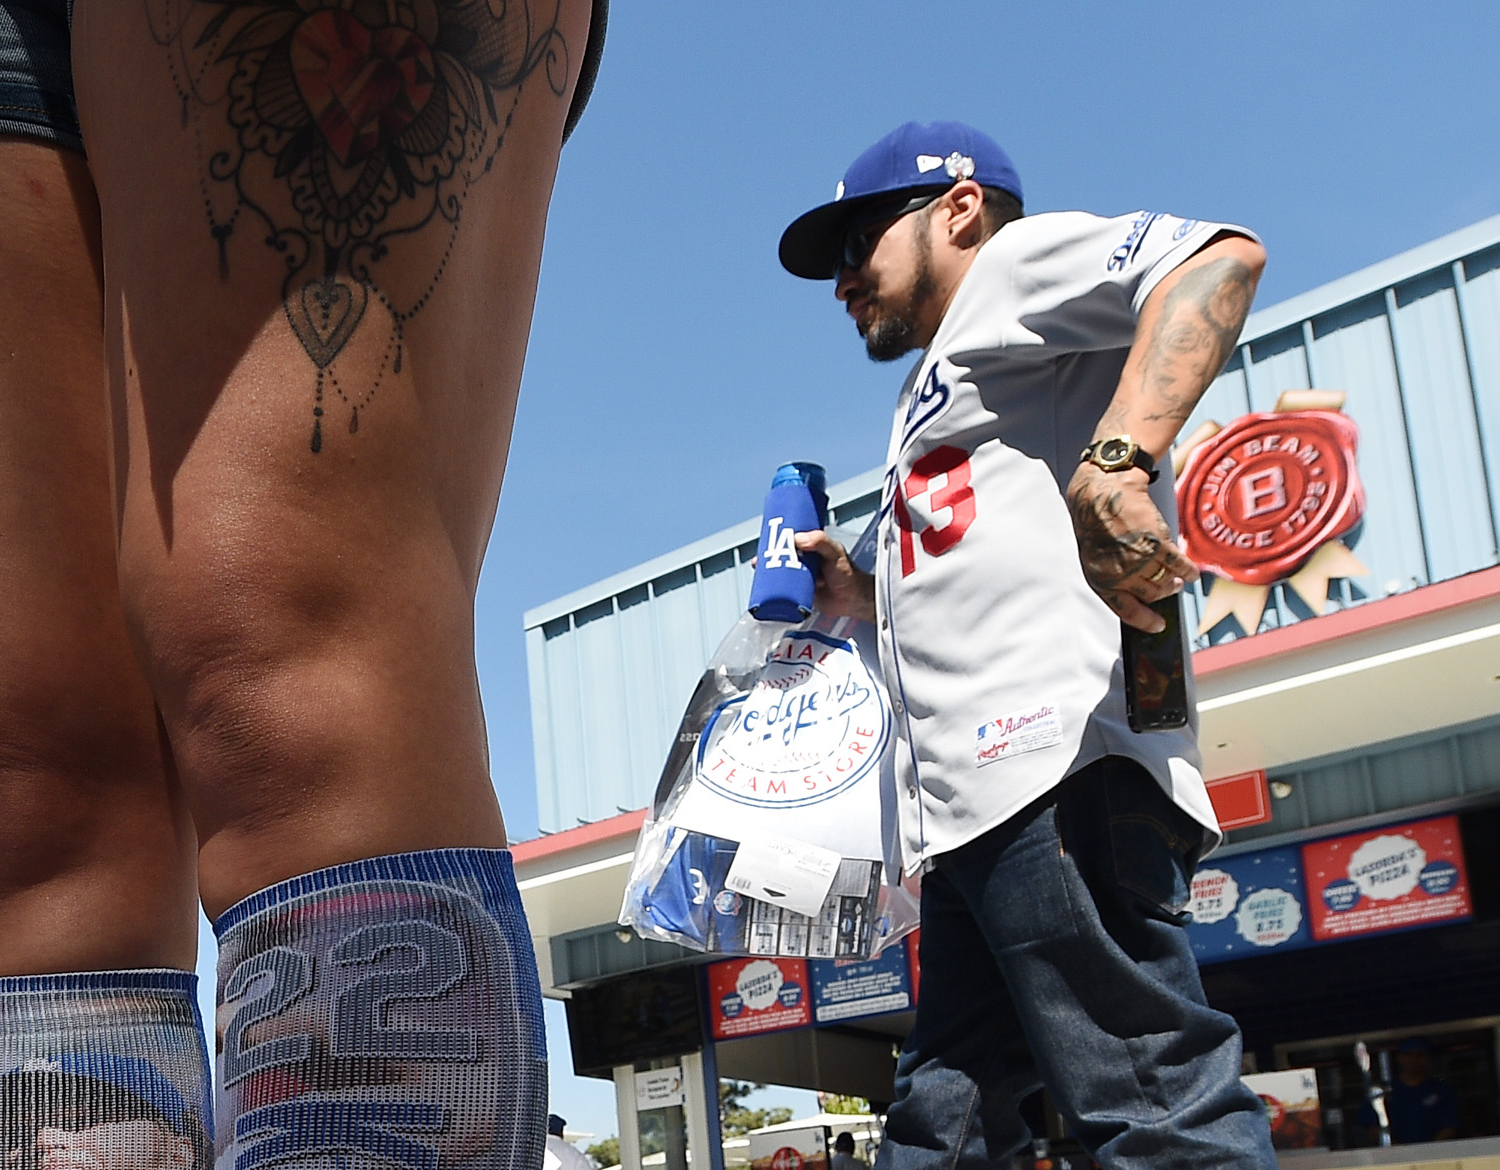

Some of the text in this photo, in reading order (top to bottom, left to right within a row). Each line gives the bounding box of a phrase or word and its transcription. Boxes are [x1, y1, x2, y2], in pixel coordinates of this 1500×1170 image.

[1204, 434, 1322, 496] JIM BEAM
[894, 444, 978, 579] 13
[1240, 466, 1287, 520] B
[764, 517, 803, 570] LA
[1202, 516, 1274, 549] SINCE
[1000, 706, 1054, 738] Authentic
[711, 726, 875, 795] TEAM STORE
[1192, 876, 1228, 890] RENCH
[1369, 865, 1410, 887] PIZZA
[224, 919, 481, 1090] 22
